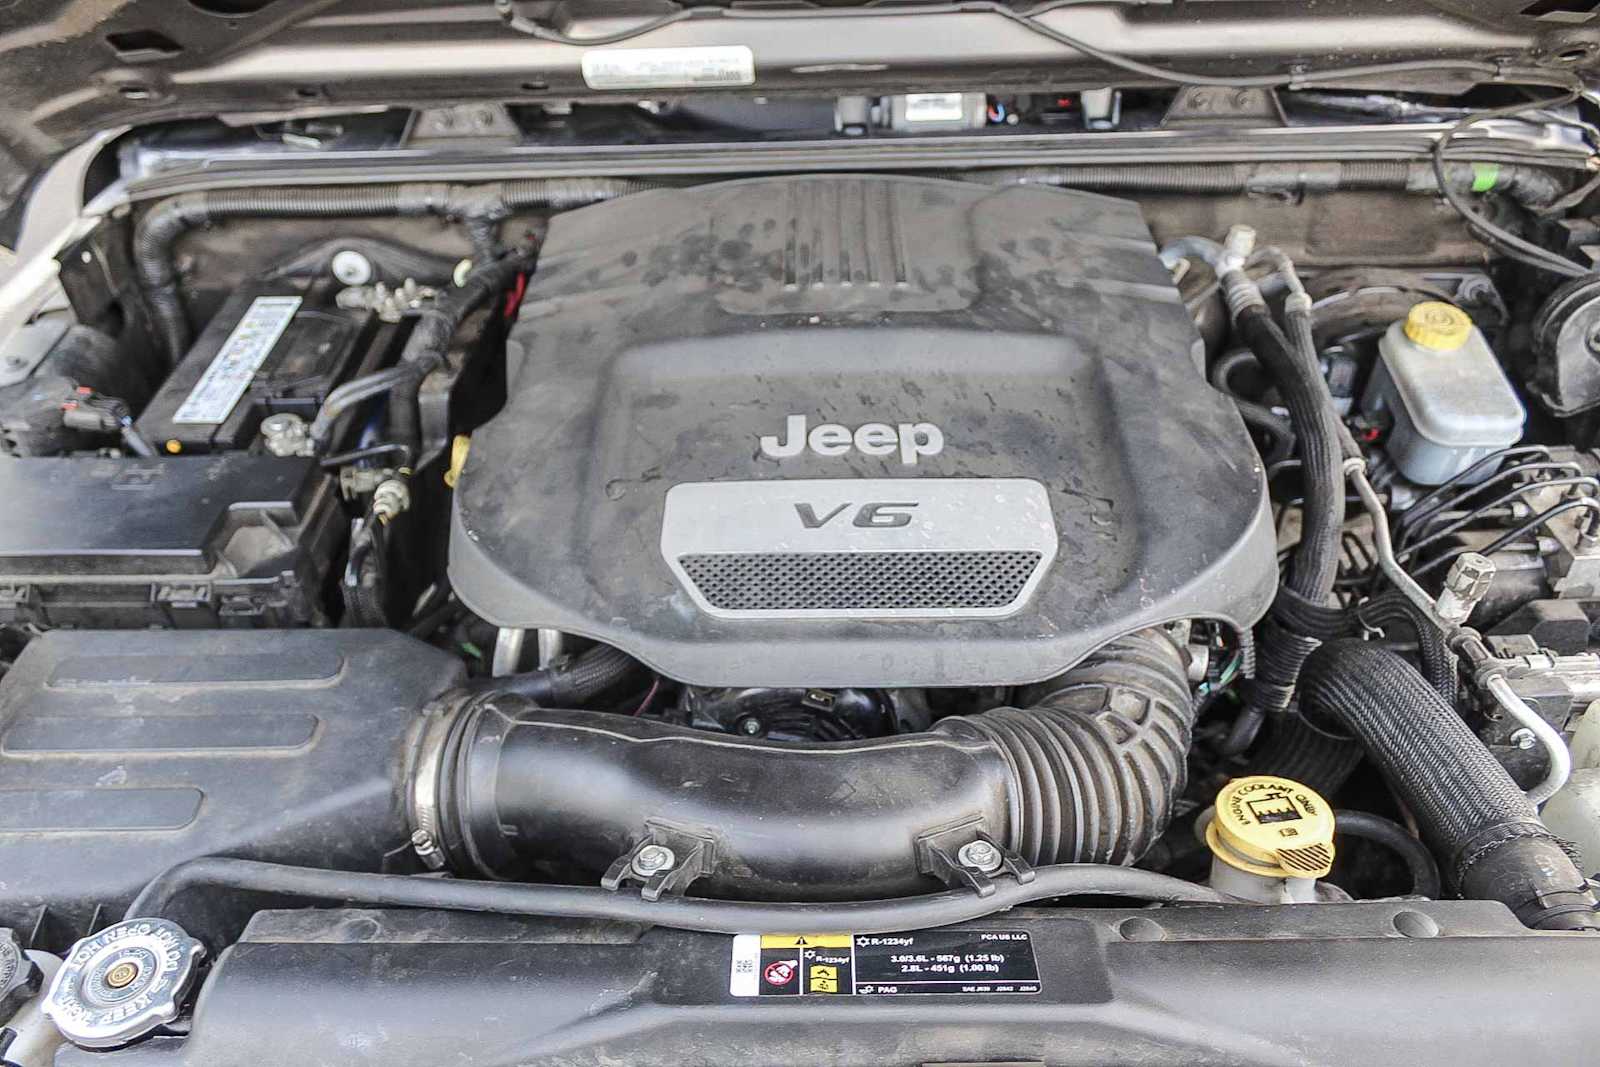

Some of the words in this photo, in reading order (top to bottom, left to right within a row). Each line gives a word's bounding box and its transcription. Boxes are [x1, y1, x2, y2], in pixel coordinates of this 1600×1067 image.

[760, 414, 945, 465] Jeep
[794, 502, 919, 529] V6
[1238, 783, 1295, 796] COOLANT
[1295, 793, 1318, 817] ONLY
[106, 923, 151, 944] OPEN
[871, 937, 914, 947] R-1234yf
[959, 964, 984, 973] (1.00
[985, 964, 1000, 973] lb)
[965, 954, 990, 963] (1.25
[990, 954, 1005, 963] lb)
[877, 986, 898, 994] PAG
[99, 993, 153, 1024] KEEP
